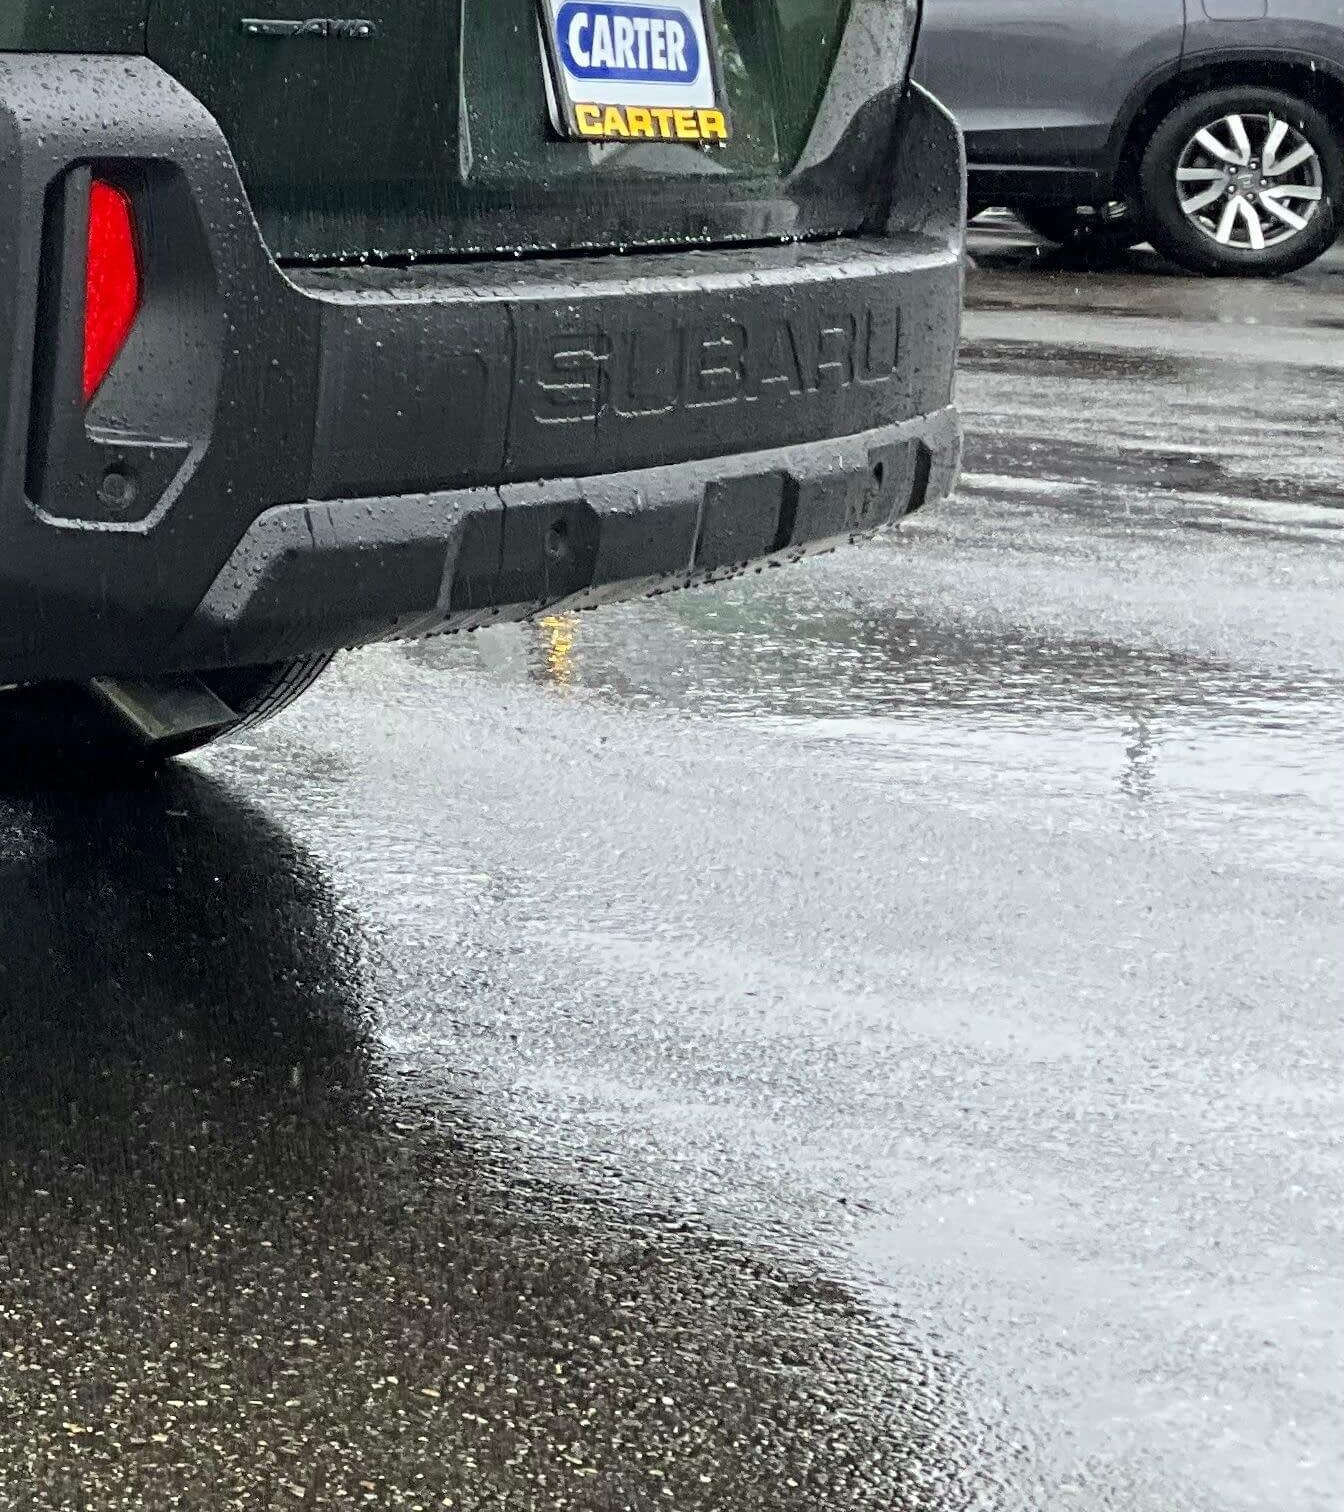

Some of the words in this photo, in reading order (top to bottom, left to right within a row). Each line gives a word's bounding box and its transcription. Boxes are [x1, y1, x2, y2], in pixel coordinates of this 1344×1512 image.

[568, 12, 688, 72] CARTER
[575, 104, 728, 138] CARTER
[534, 306, 902, 423] SUBARU
